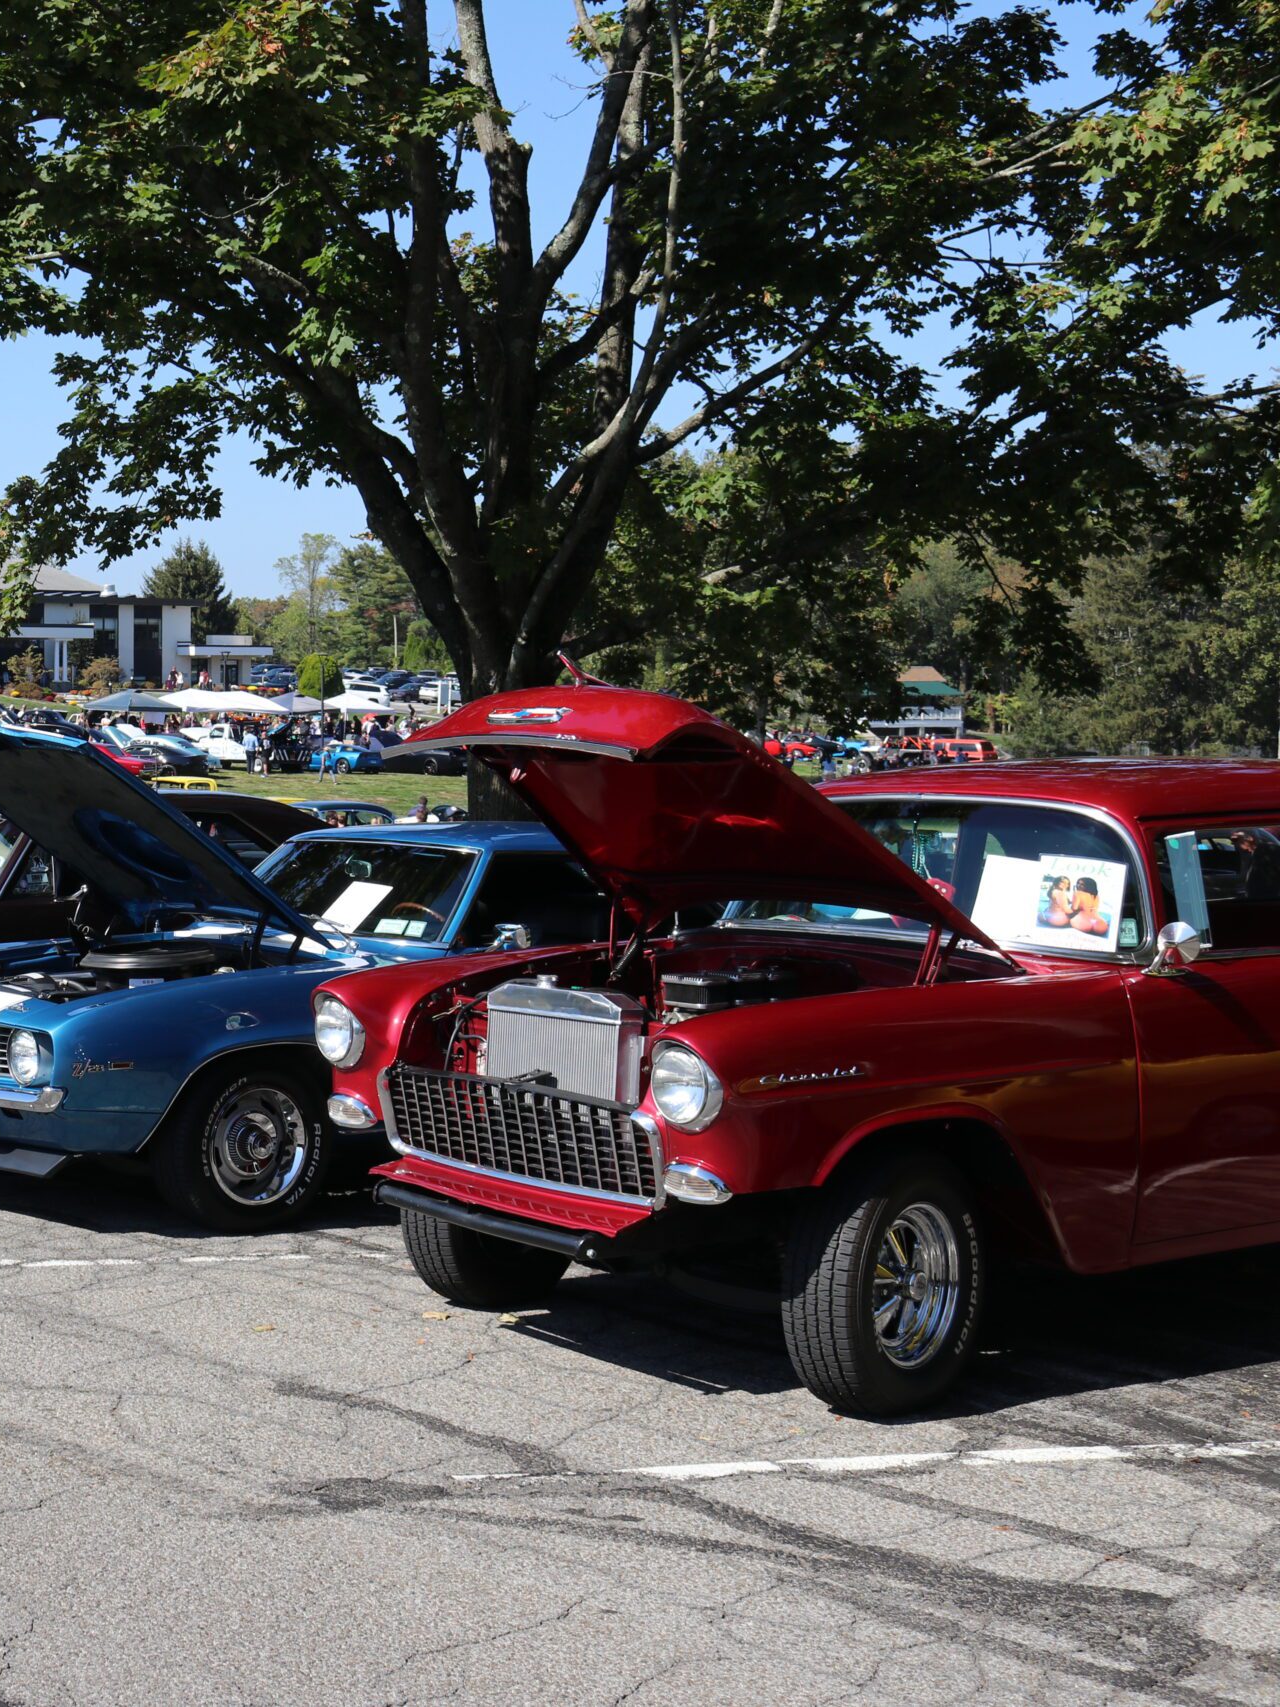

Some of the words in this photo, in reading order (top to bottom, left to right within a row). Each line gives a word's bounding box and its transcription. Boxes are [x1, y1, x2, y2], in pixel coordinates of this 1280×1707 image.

[1050, 857, 1112, 878] Look
[759, 1066, 857, 1085] Chevrolet
[305, 1123, 322, 1184] Radial
[285, 1186, 307, 1206] T/A
